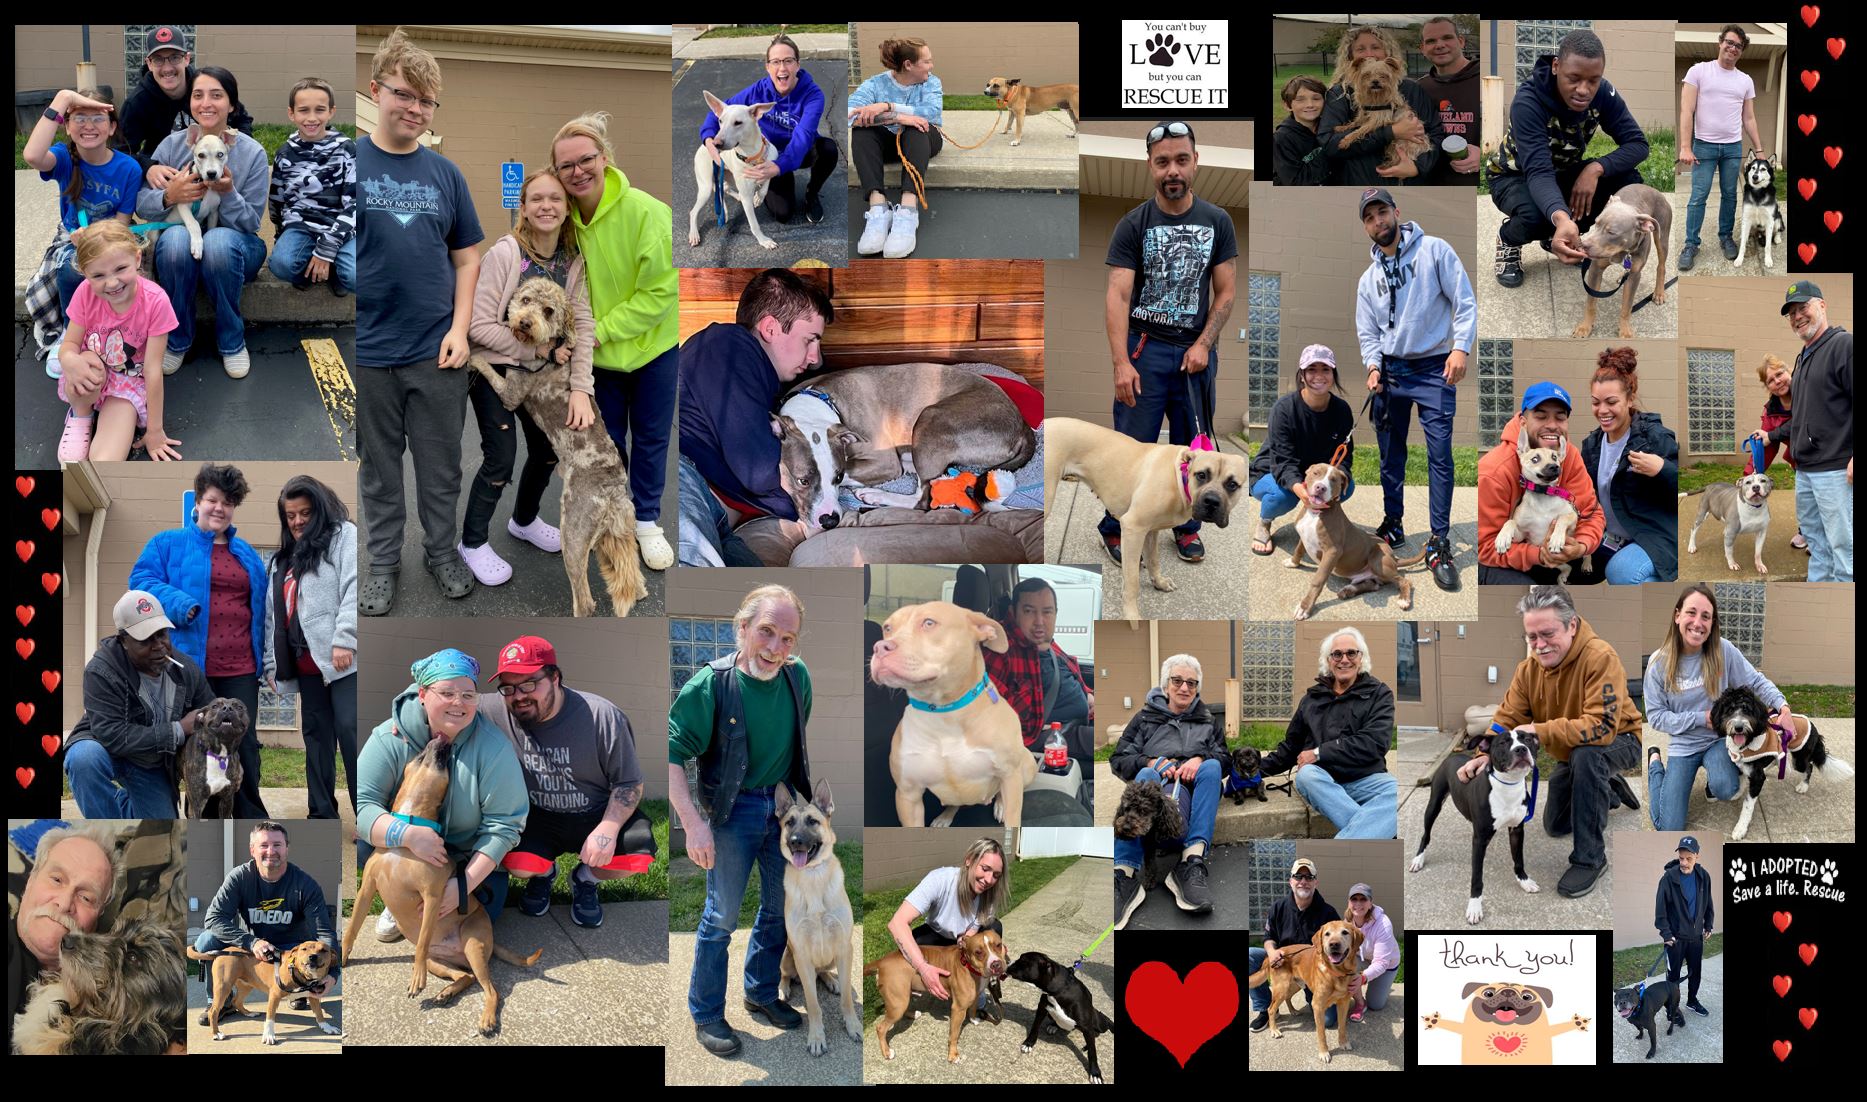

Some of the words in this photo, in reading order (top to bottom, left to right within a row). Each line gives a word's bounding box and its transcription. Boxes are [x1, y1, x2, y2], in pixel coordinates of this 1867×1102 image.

[366, 197, 392, 207] ROCKY
[395, 201, 438, 211] MOUNTAIN
[1376, 259, 1417, 298] NVY
[546, 747, 570, 764] CAN
[529, 790, 589, 809] STANDING
